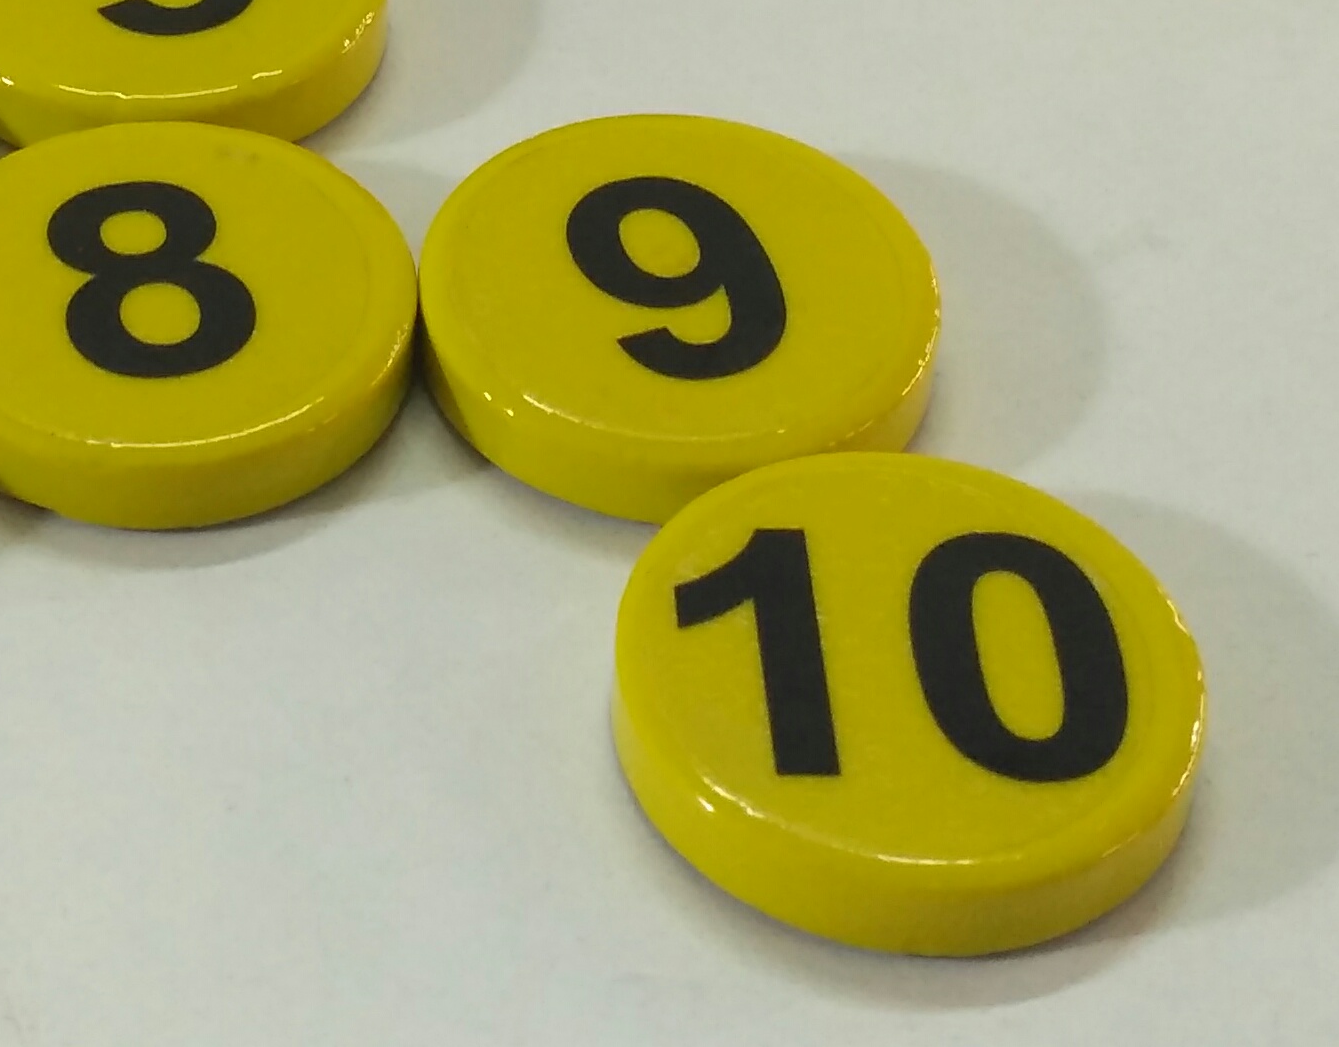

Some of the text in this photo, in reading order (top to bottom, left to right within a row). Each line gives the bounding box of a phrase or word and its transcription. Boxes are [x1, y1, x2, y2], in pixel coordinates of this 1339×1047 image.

[47, 182, 256, 378] 8
[566, 177, 786, 380] 9
[675, 529, 1128, 783] 10
